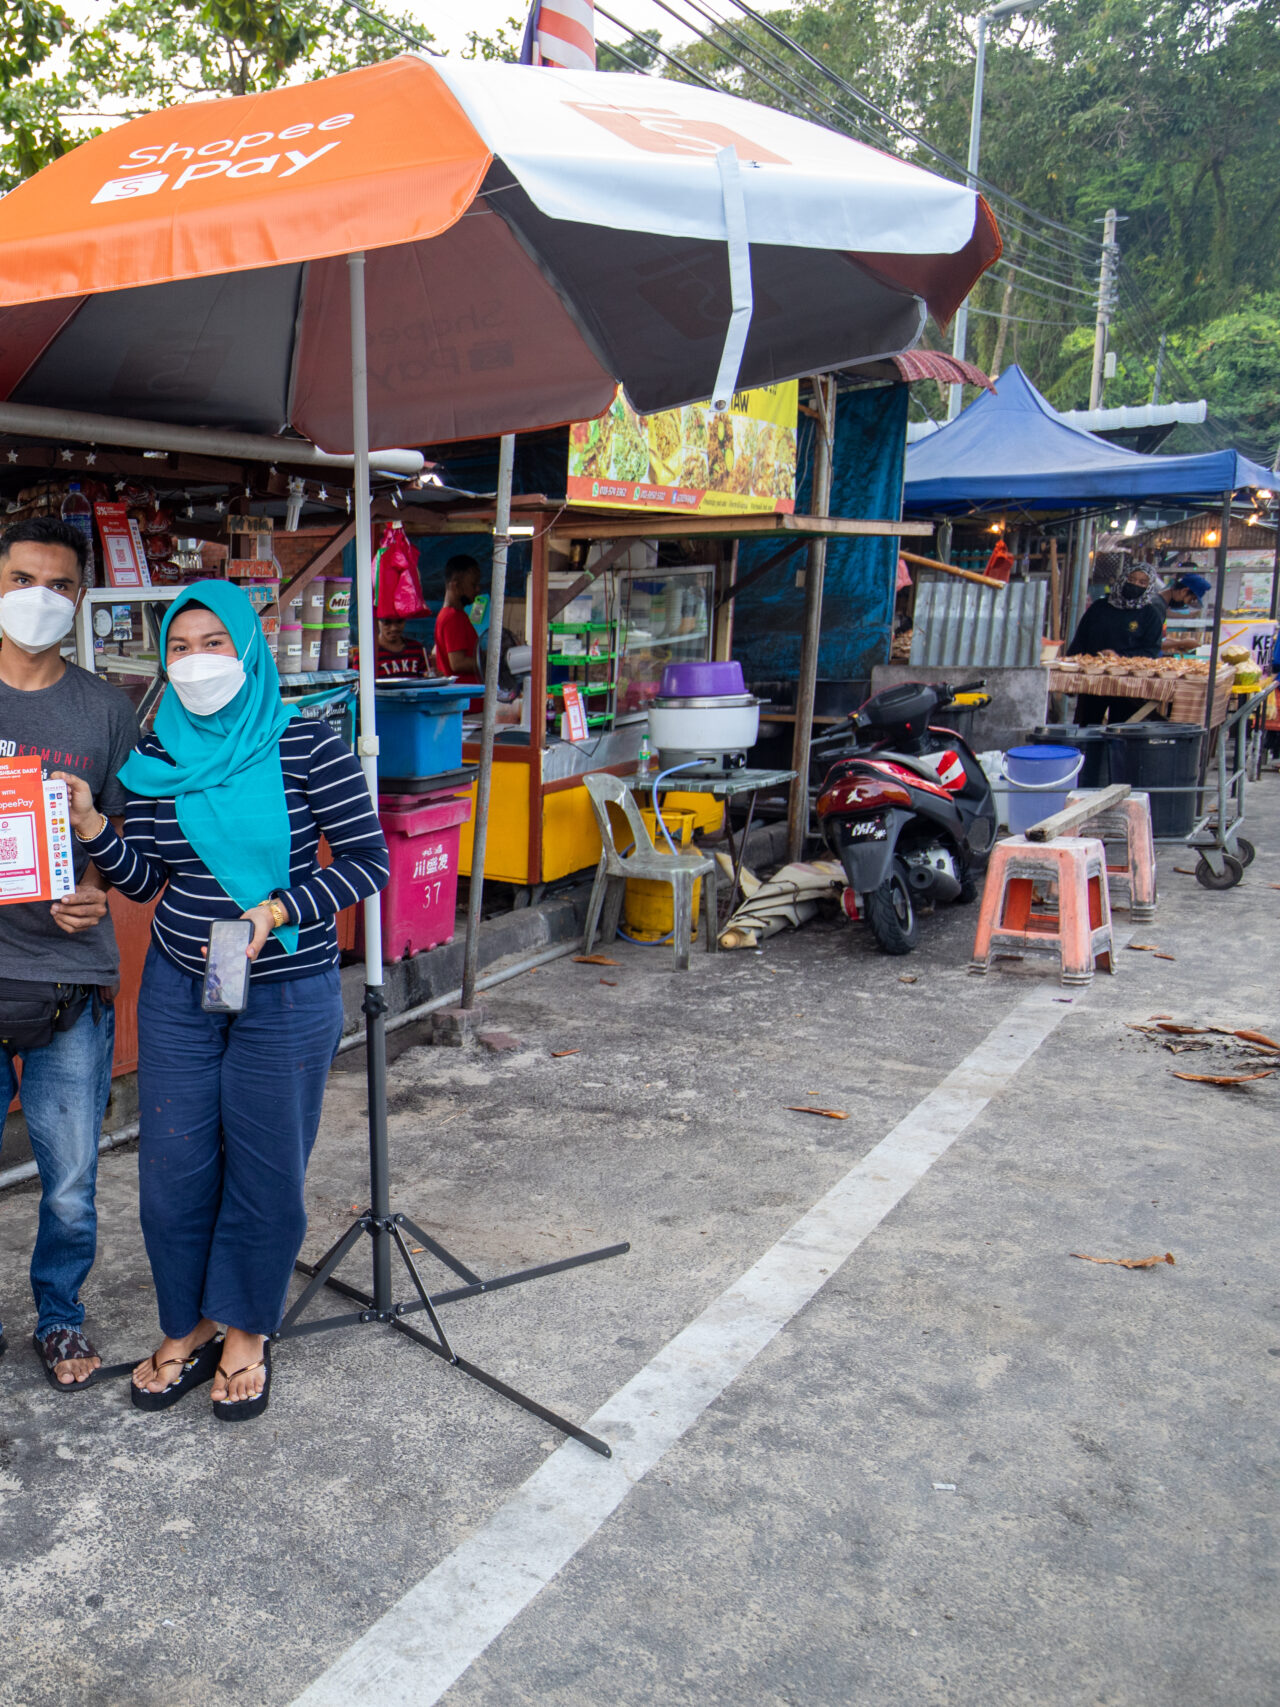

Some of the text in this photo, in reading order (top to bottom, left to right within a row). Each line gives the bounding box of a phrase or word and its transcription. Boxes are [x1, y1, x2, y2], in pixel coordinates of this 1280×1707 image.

[119, 113, 355, 170] Shopee
[171, 141, 341, 191] Pay
[380, 659, 419, 675] TAKE
[423, 881, 441, 909] 37
